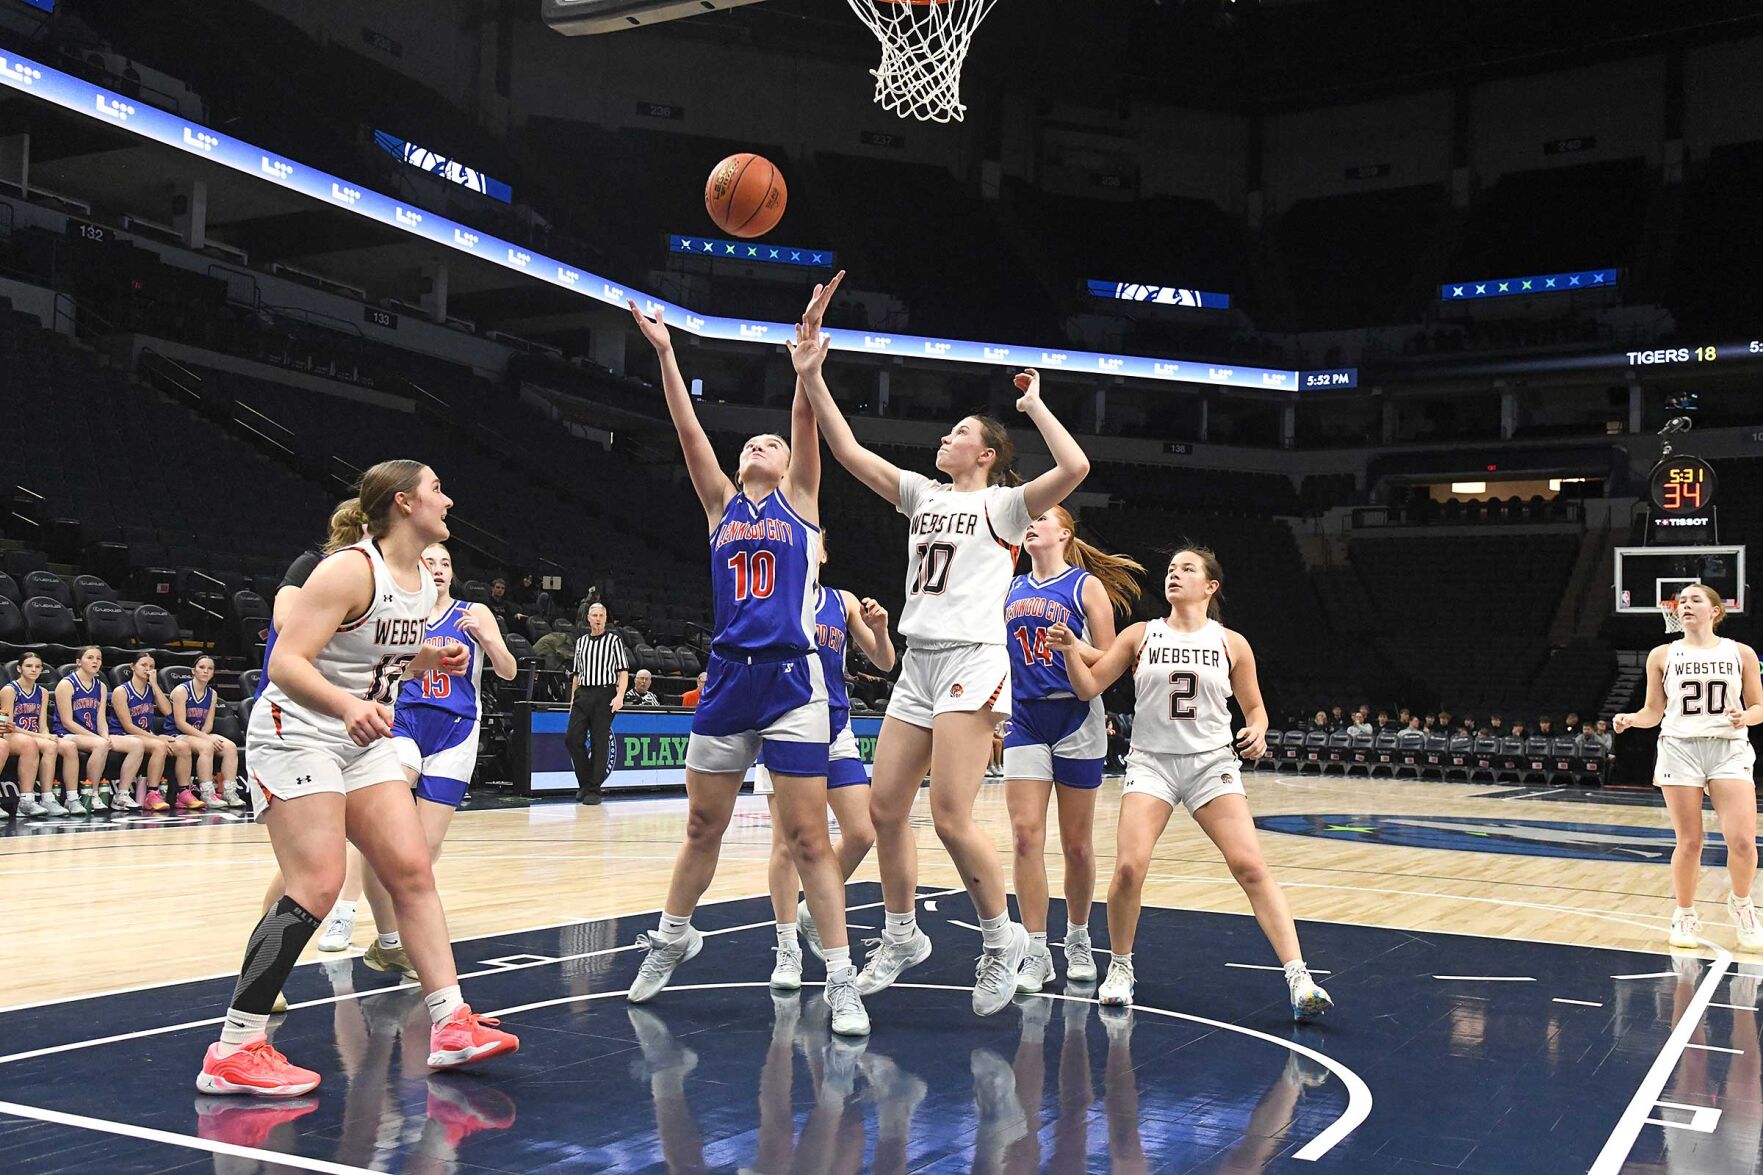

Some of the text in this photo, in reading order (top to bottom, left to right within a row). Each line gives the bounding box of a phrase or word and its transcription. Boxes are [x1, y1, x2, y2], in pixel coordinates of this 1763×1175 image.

[80, 225, 103, 242] 132
[374, 312, 390, 325] 133
[1627, 346, 1717, 365] TIGERS 18
[1750, 341, 1763, 353] 5:
[1306, 373, 1350, 387] 5:52 PM
[1752, 432, 1763, 441] 10
[1670, 468, 1704, 483] 5:31
[1664, 484, 1700, 508] 34
[766, 518, 793, 546] CITY
[911, 513, 977, 535] WEBSTER
[1670, 517, 1709, 527] TISSOT
[728, 550, 775, 601] 10
[912, 541, 957, 596] 10
[375, 616, 428, 646] WEBST
[1014, 626, 1053, 666] 14
[1149, 647, 1219, 668] WEBSTER
[1675, 662, 1733, 676] WEBSTER
[422, 668, 452, 699] 15
[1168, 671, 1198, 720] 2
[1679, 679, 1728, 716] 20
[624, 737, 690, 767] PLAY
